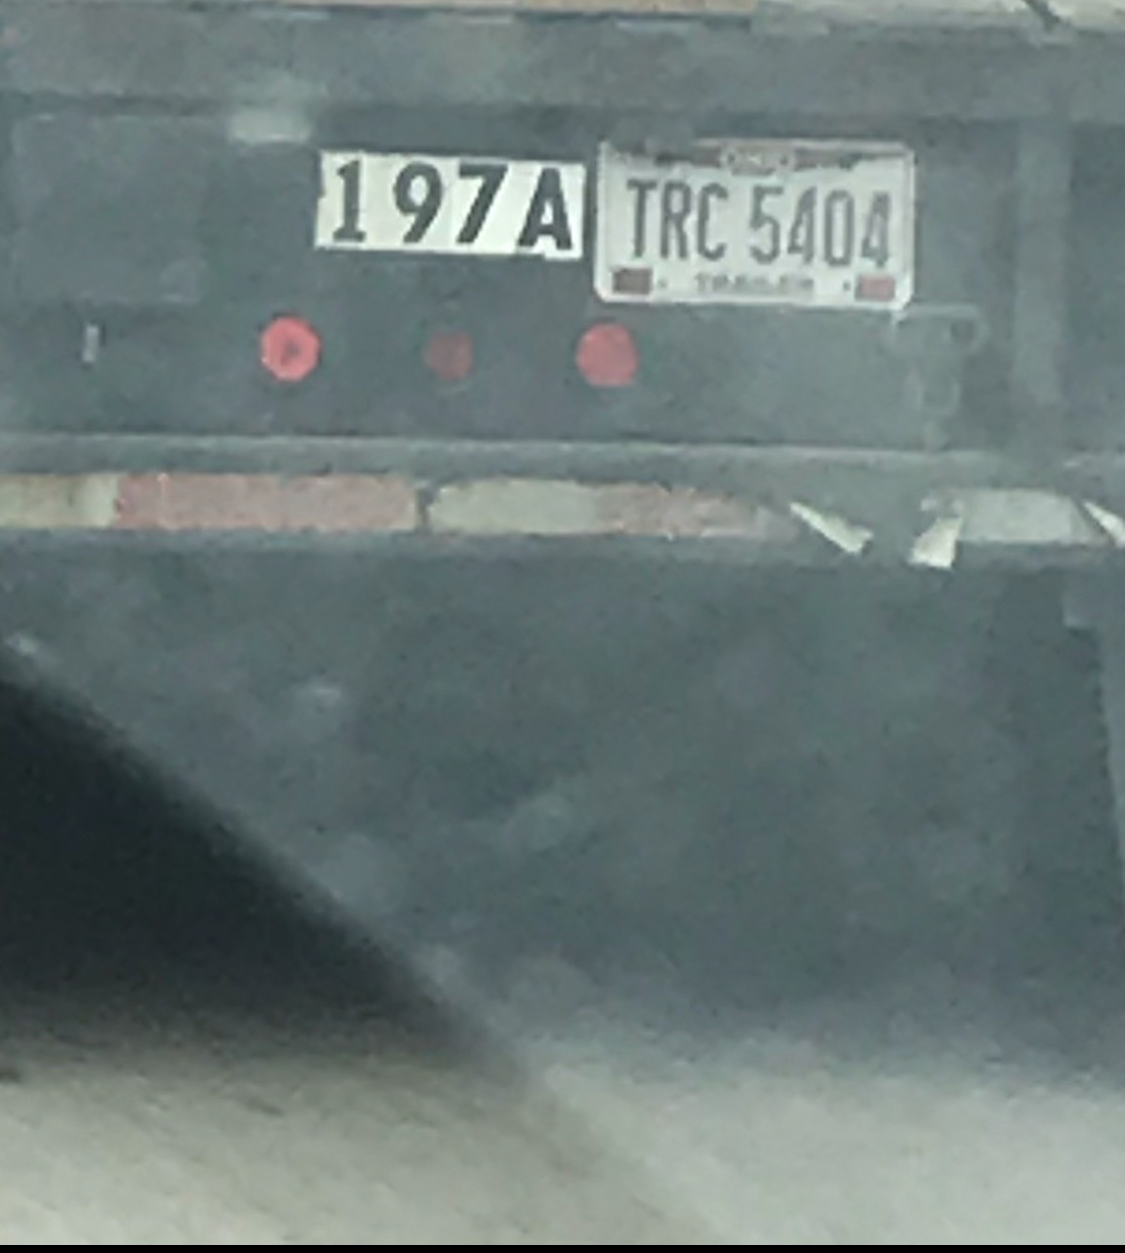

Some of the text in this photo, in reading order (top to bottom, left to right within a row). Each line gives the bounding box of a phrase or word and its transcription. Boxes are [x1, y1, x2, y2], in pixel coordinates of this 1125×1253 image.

[332, 158, 575, 250] 197A
[626, 177, 892, 268] TRC 5404
